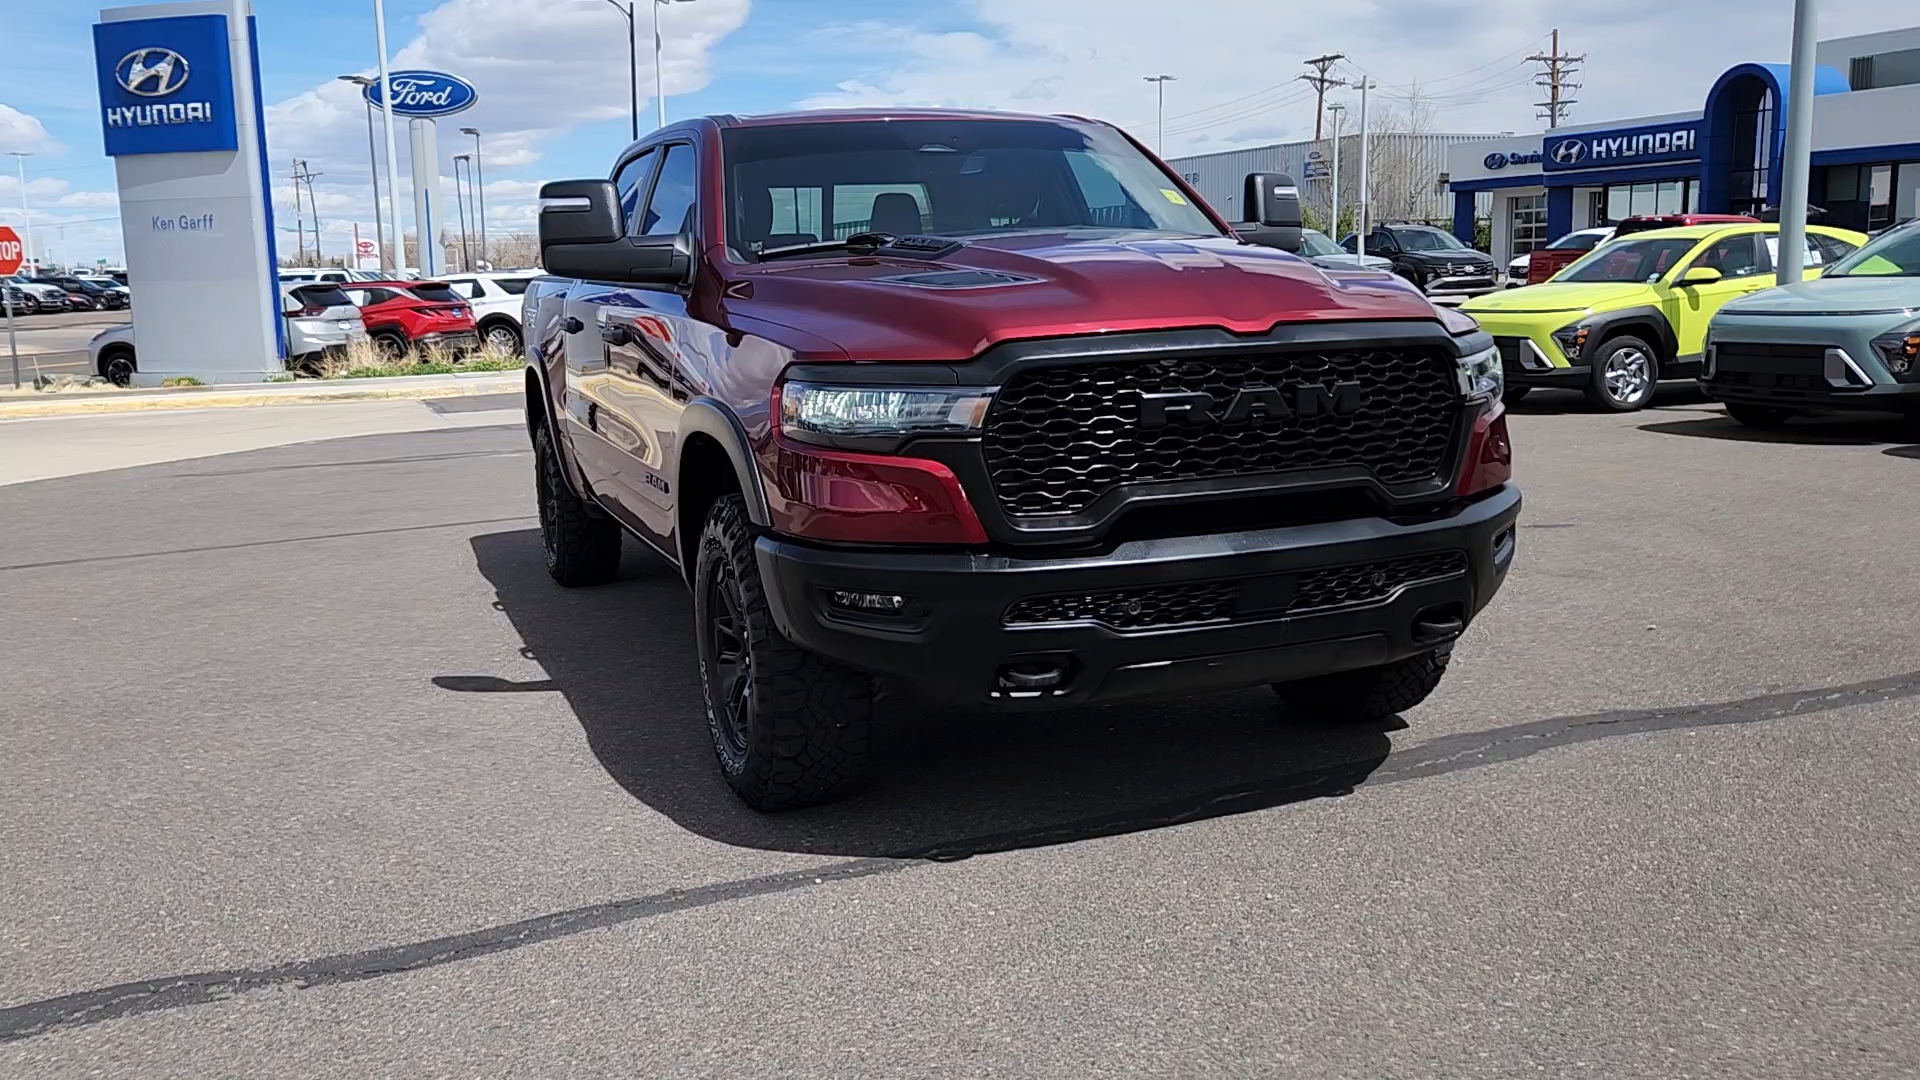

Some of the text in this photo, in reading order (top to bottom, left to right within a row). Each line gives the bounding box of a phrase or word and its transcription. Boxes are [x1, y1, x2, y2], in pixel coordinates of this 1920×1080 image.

[391, 79, 453, 105] Ford
[107, 102, 212, 127] HYUNDAI
[1592, 129, 1696, 159] HYUNDAI
[151, 214, 214, 231] Ken Garff
[1141, 381, 1361, 427] RAM
